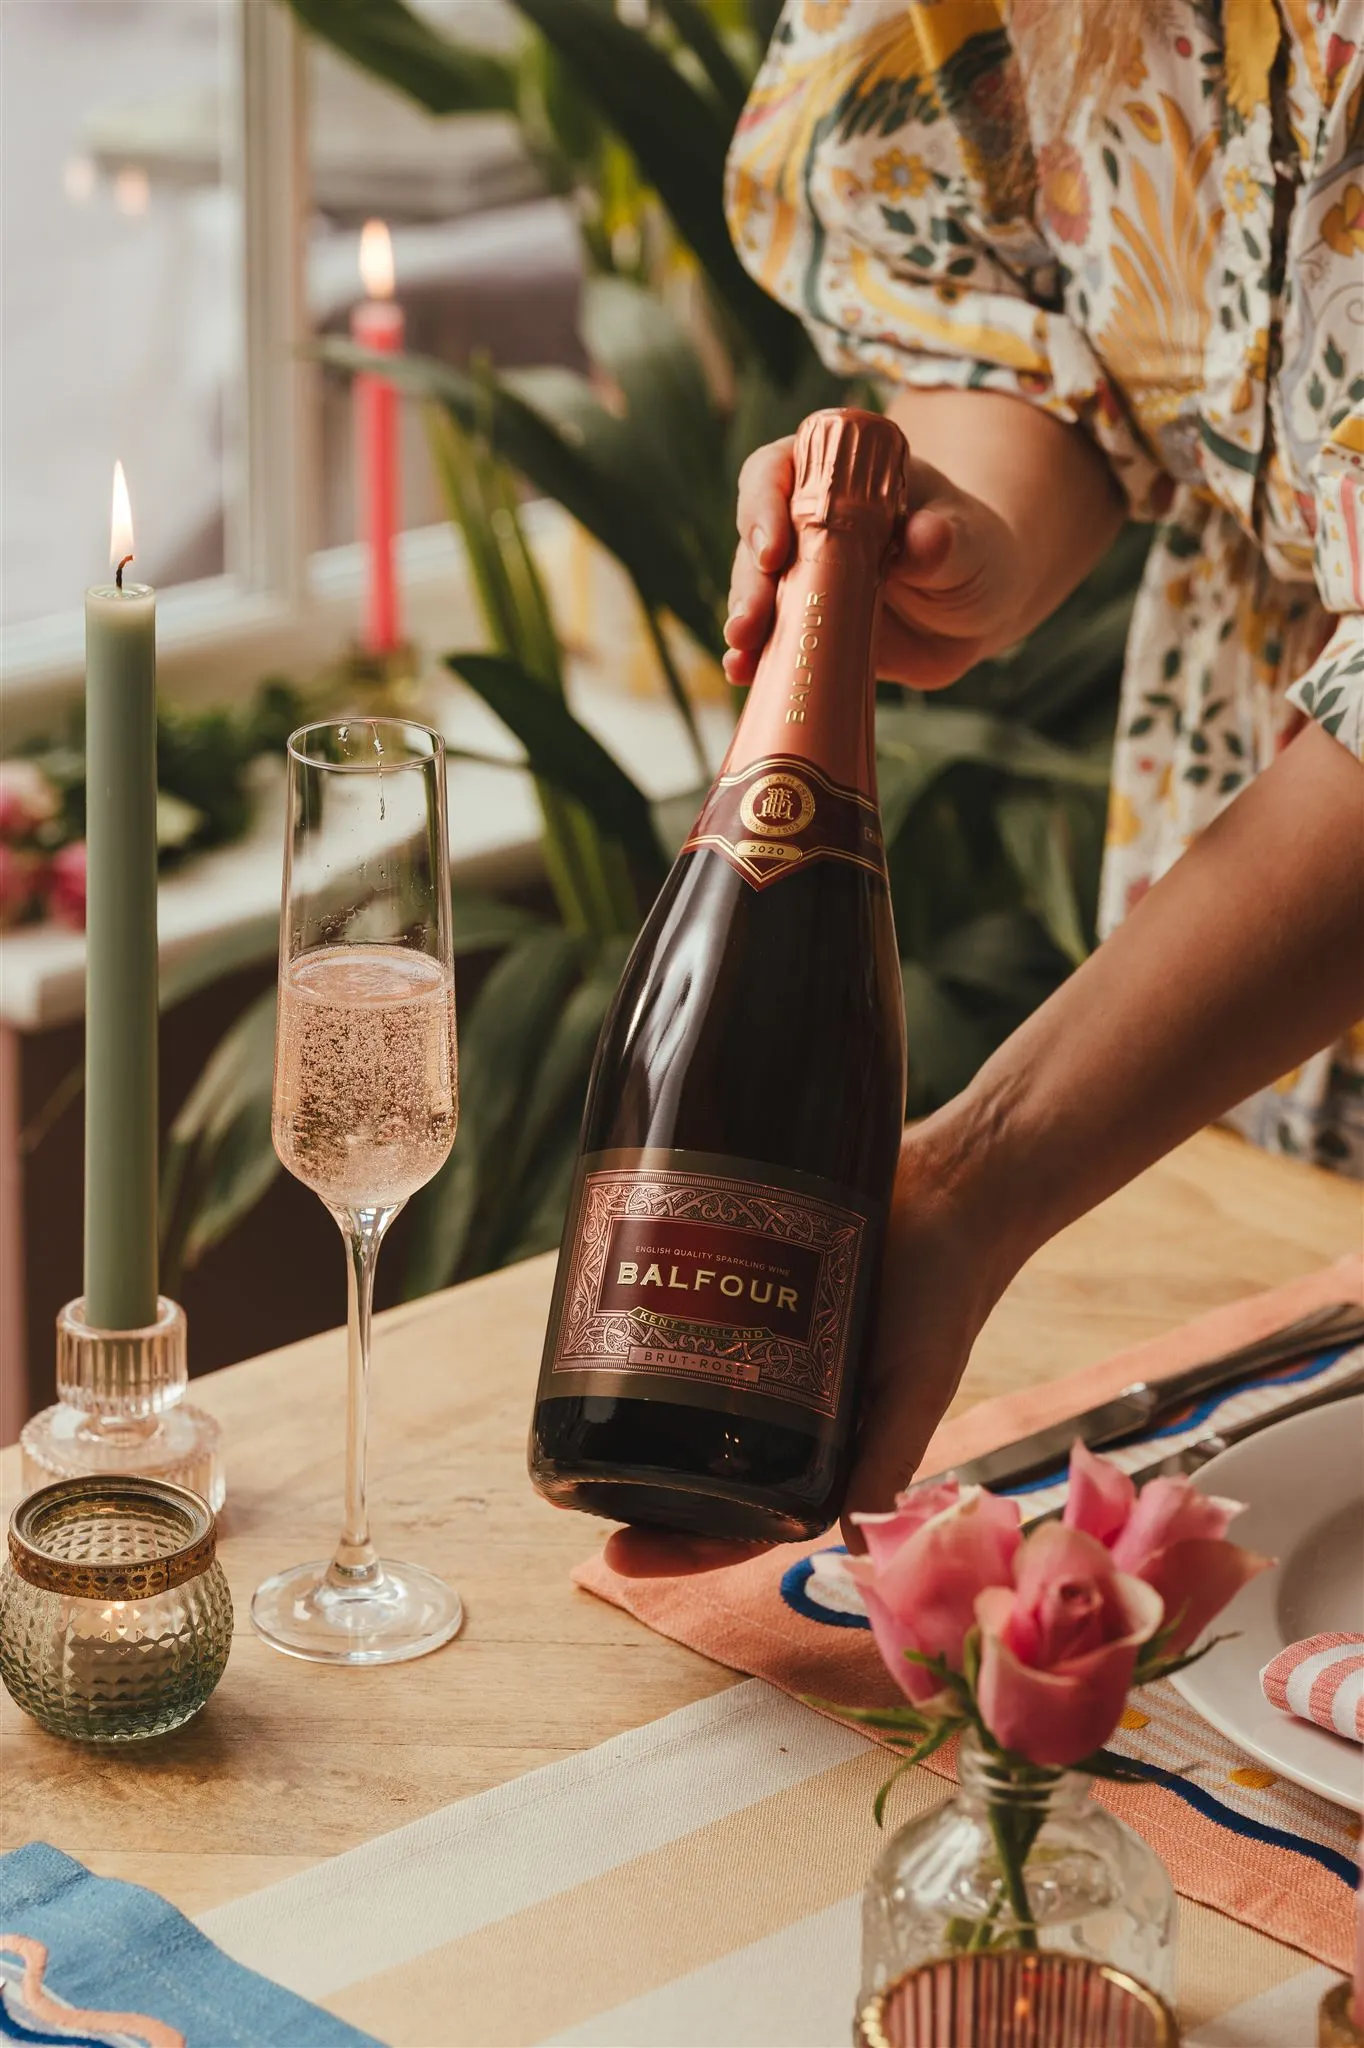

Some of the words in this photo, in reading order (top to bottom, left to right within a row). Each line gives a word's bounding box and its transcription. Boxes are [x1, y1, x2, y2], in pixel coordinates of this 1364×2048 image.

[785, 591, 827, 724] BALFOUR
[750, 845, 784, 856] 2020
[635, 1245, 671, 1255] ENGLISH
[673, 1248, 713, 1259] QUALITY
[715, 1254, 766, 1271] SPARKLING
[768, 1265, 791, 1277] WINE
[617, 1261, 799, 1312] BALFOUR
